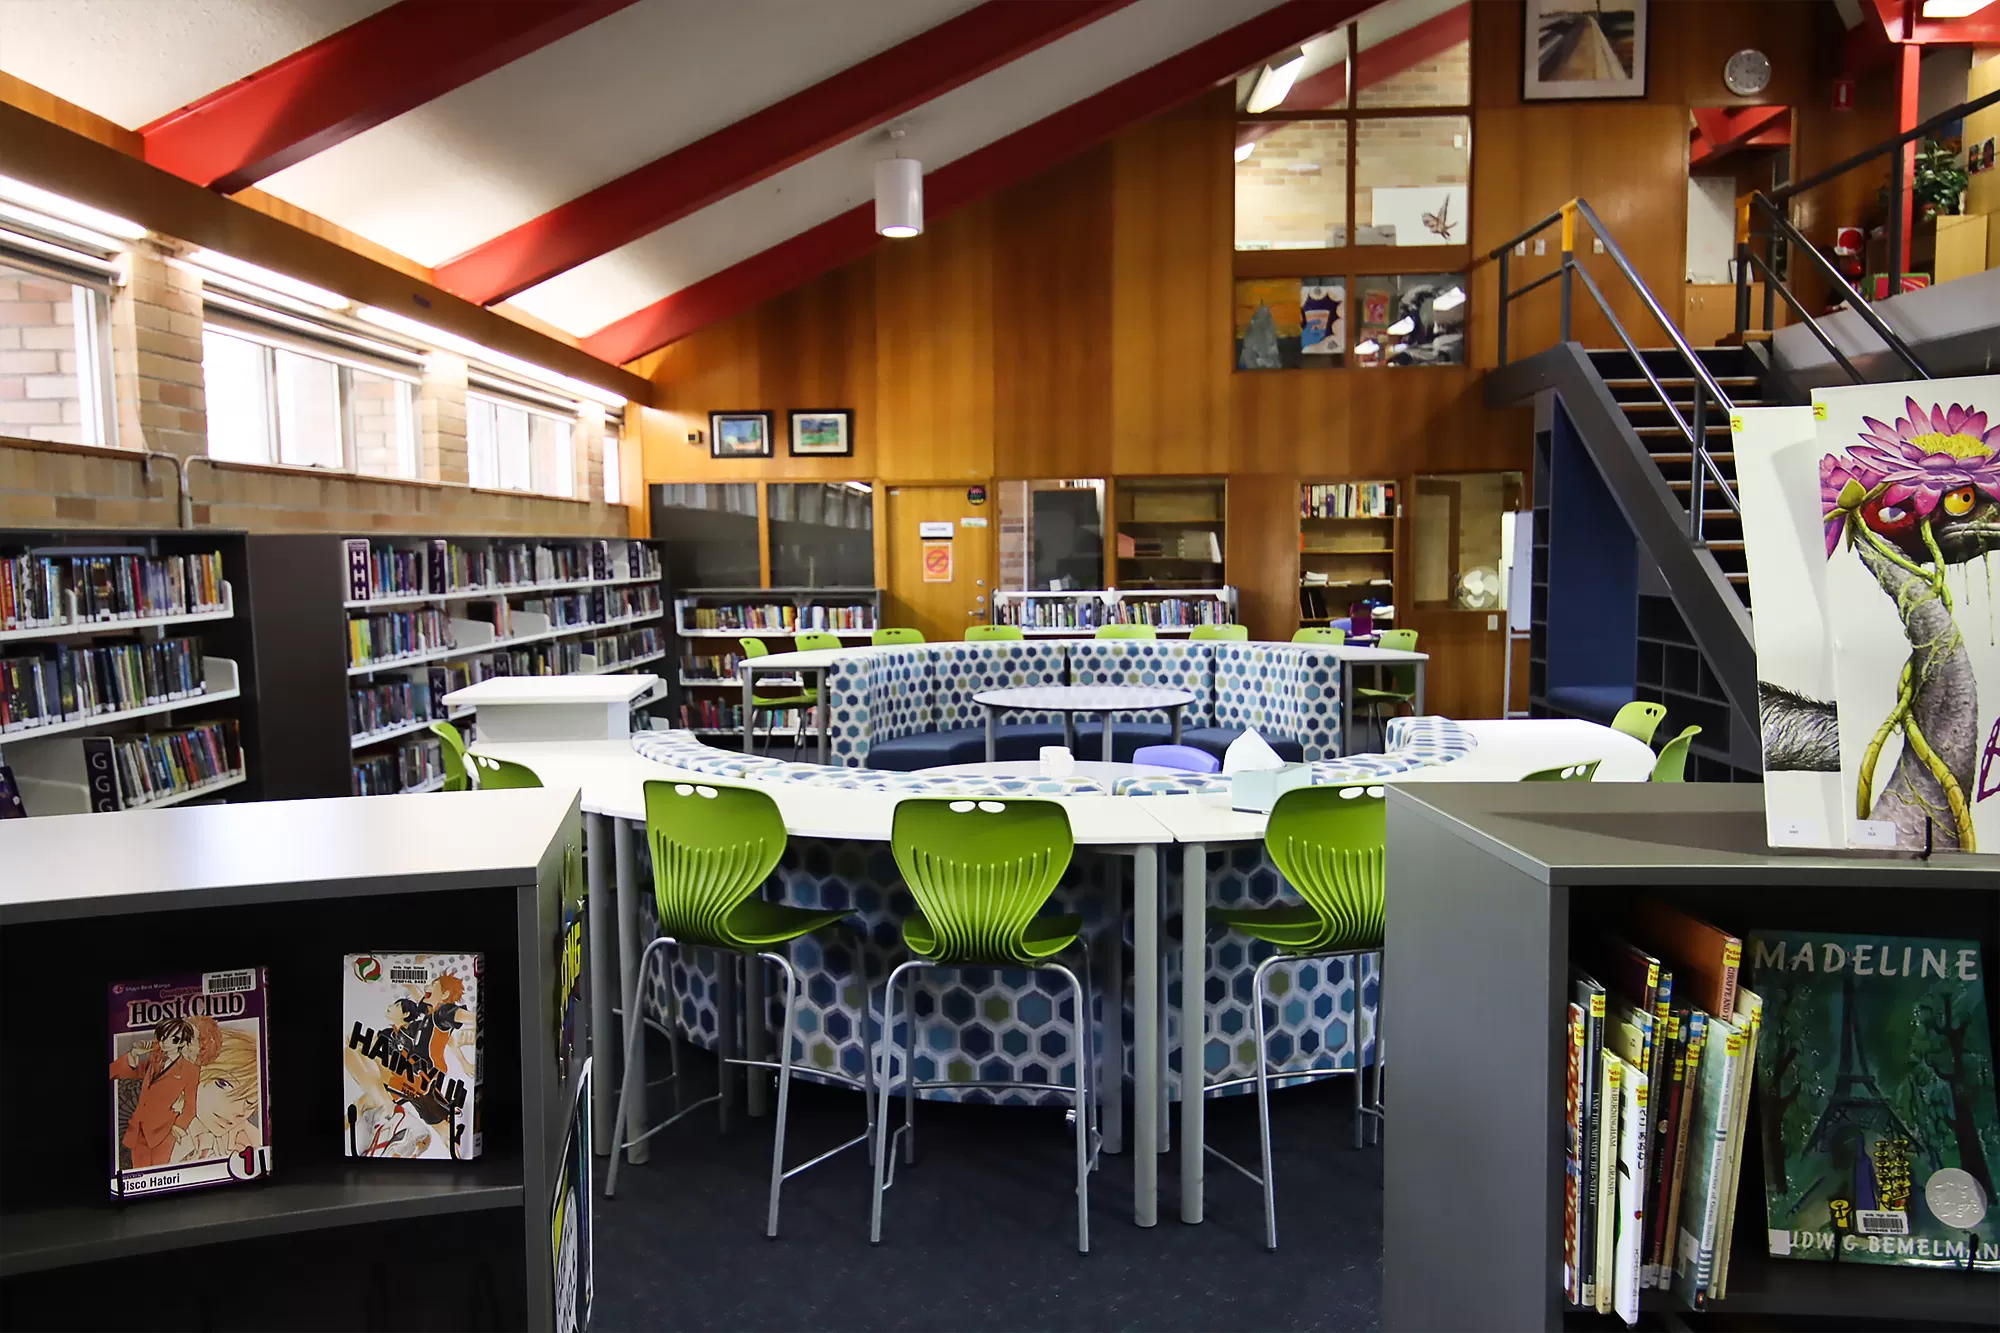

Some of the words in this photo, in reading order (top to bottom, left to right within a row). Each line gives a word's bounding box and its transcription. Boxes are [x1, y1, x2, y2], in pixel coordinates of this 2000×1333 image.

[1754, 941, 1978, 980] MADELINE
[130, 996, 185, 1026] Host
[191, 993, 244, 1016] Club
[149, 1173, 181, 1187] Hatori
